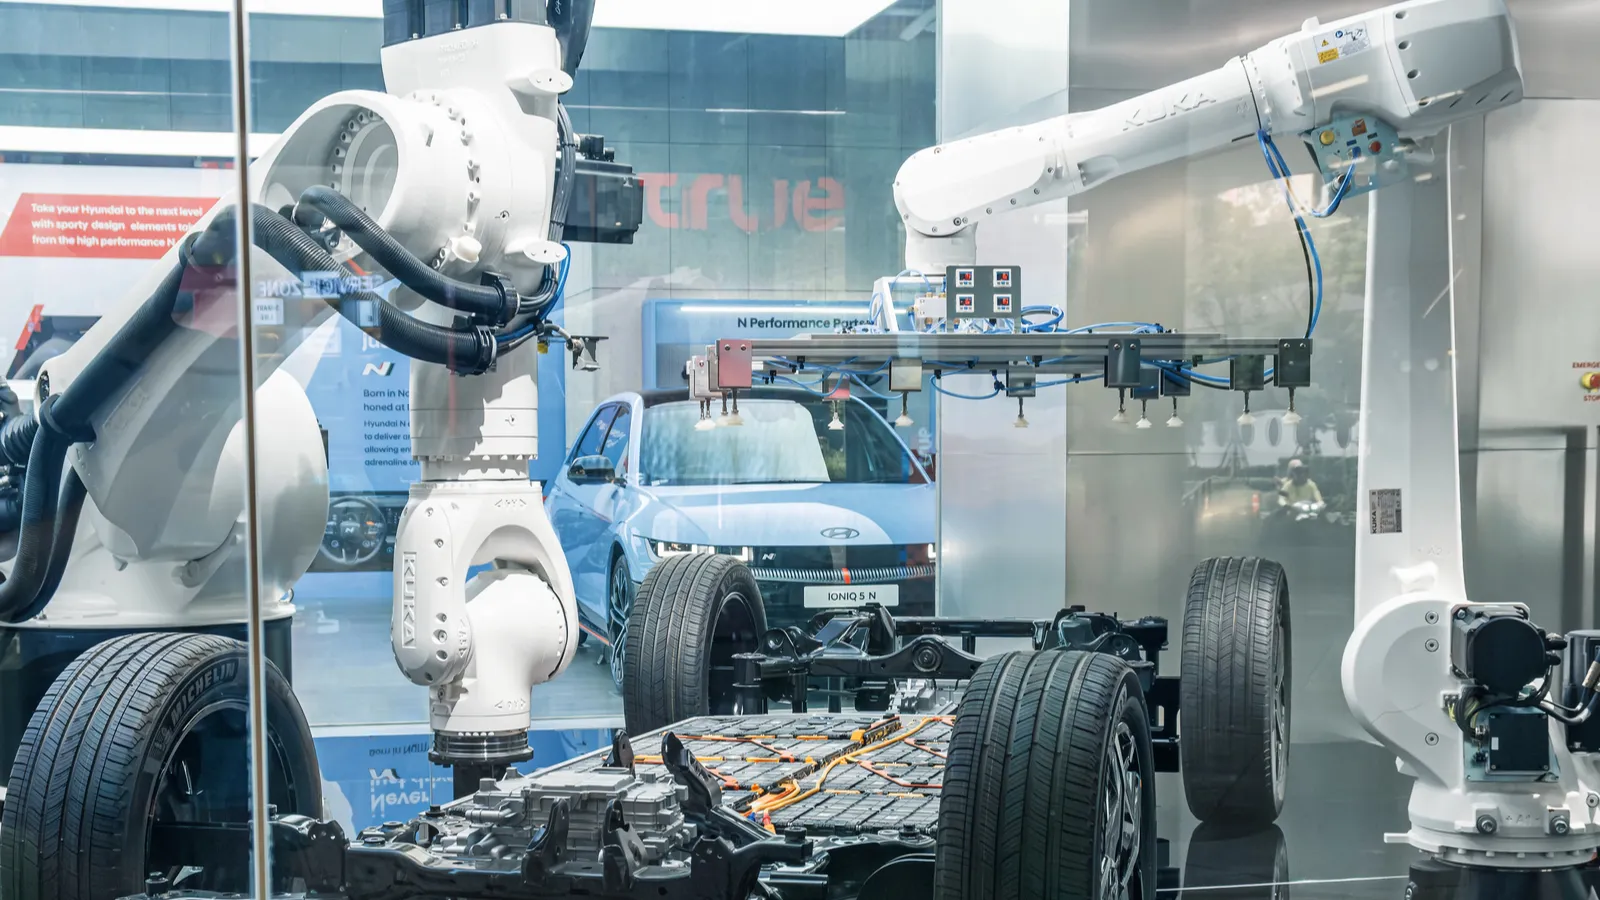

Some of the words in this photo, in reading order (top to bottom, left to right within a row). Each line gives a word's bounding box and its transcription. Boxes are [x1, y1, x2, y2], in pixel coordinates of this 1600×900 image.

[31, 203, 55, 213] Take
[56, 204, 79, 216] your
[81, 204, 124, 217] Hyundai
[125, 206, 136, 215] to
[137, 205, 155, 216] the
[156, 206, 178, 217] next
[179, 206, 203, 218] level
[31, 219, 54, 229] with
[56, 220, 88, 232] sporty
[91, 219, 125, 232] design
[130, 221, 176, 232] elements
[32, 235, 57, 245] from
[58, 235, 75, 246] the
[76, 236, 99, 249] high
[100, 237, 165, 249] performance
[737, 318, 747, 328] N
[750, 317, 831, 329] Performance
[363, 389, 386, 398] Born
[387, 389, 396, 398] in
[363, 403, 393, 411] honed
[364, 420, 398, 429] Hyundai
[374, 432, 401, 440] deliver
[364, 445, 399, 454] allowing
[364, 458, 408, 466] adrenaline
[828, 592, 857, 602] IONIQ
[859, 591, 865, 600] 5
[868, 591, 876, 600] N
[403, 558, 415, 647] KUKA
[170, 661, 236, 728] MICHELIN
